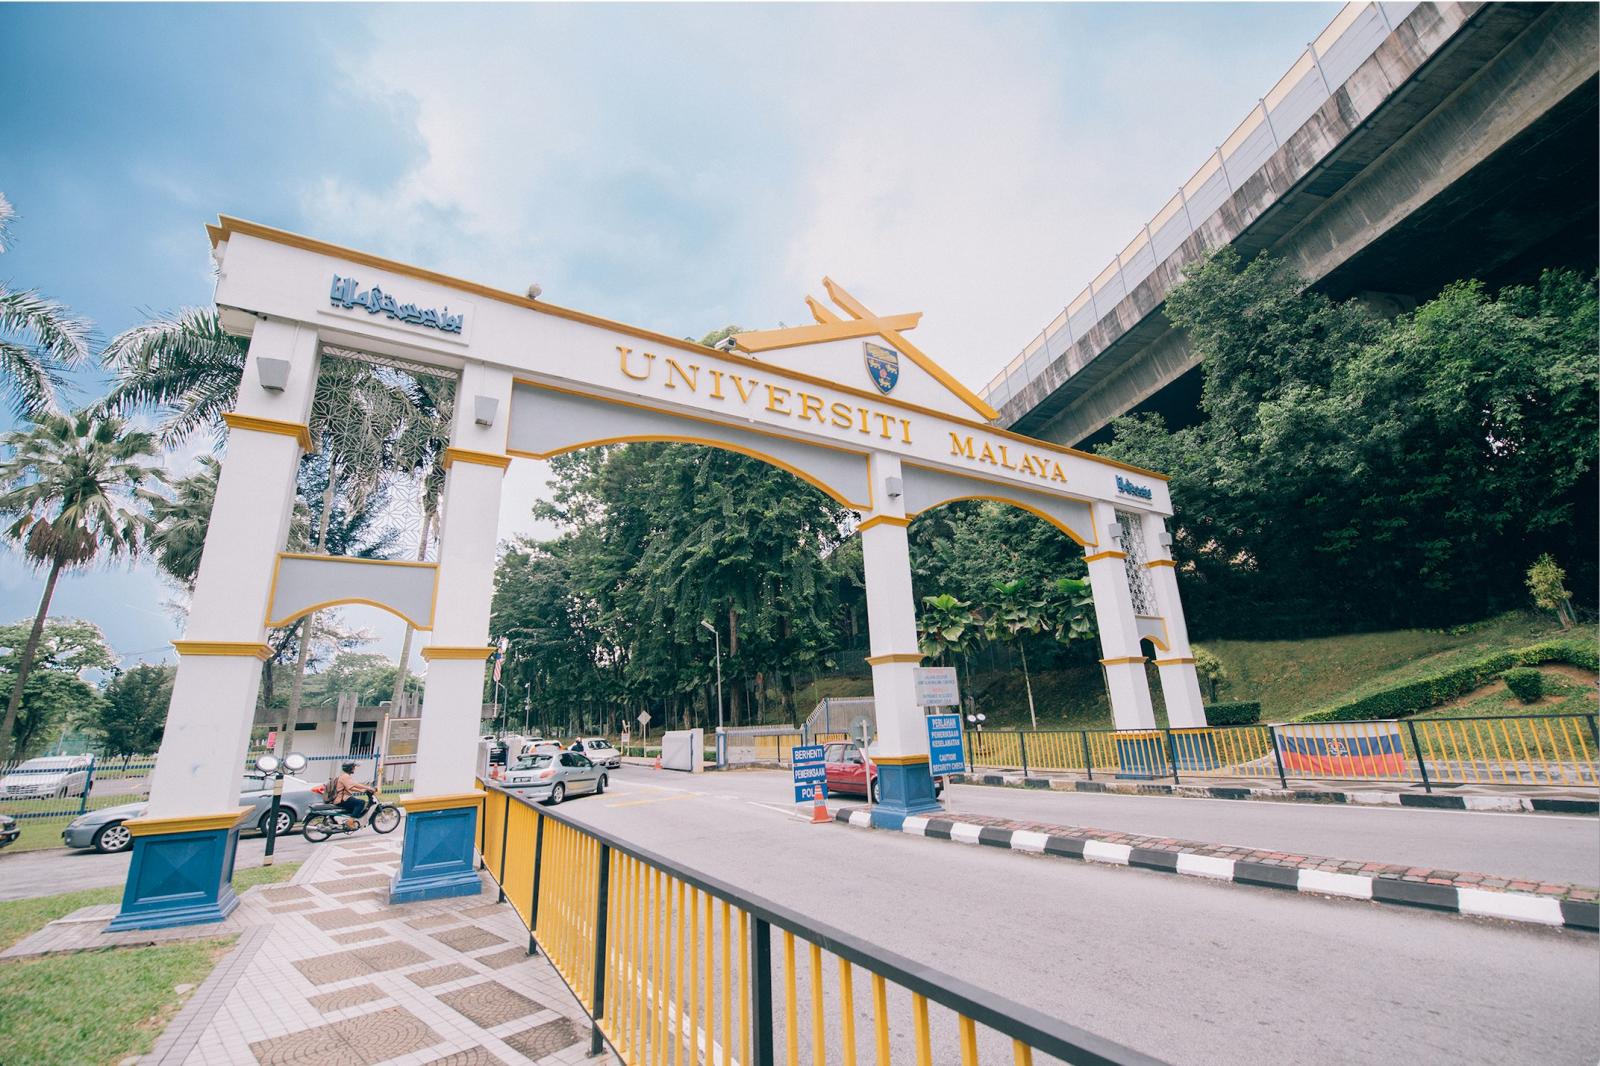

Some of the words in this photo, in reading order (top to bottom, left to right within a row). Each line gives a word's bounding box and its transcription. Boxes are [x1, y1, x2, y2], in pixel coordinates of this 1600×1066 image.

[616, 346, 912, 445] UNIVERSITI
[949, 431, 1067, 483] MALAYA
[794, 748, 823, 760] BERHENTI
[794, 767, 825, 780] PEMERIKSAAN
